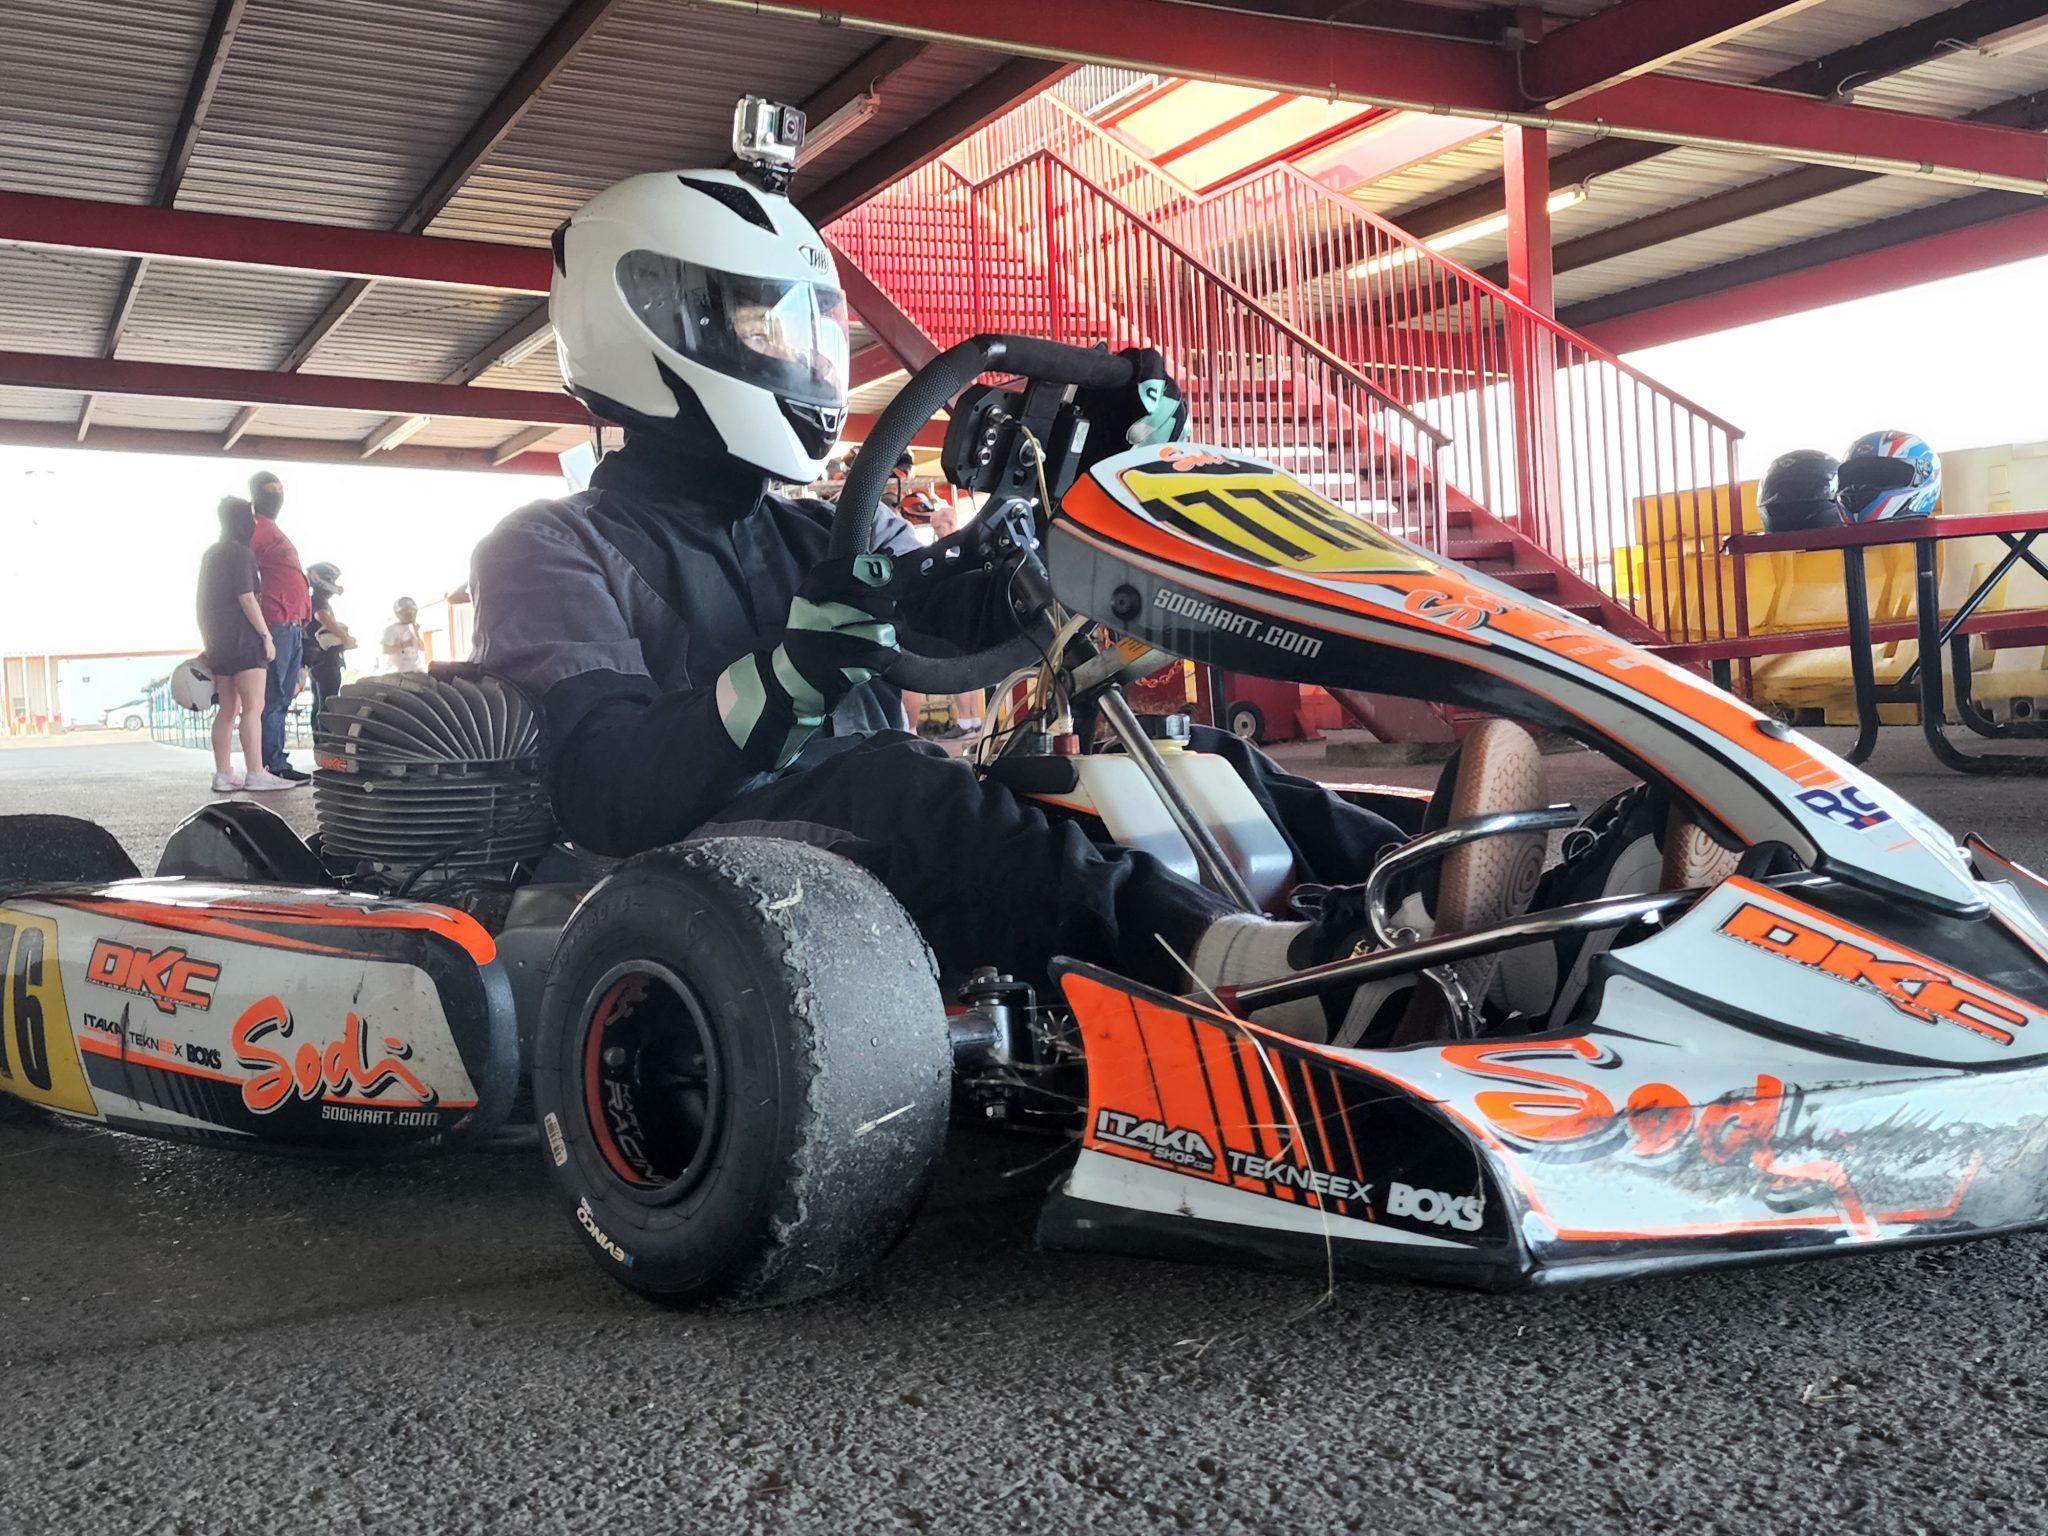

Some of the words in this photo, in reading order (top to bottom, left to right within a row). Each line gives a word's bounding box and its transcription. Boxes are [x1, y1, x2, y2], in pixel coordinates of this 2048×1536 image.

[86, 938, 222, 1015] DKC
[1716, 901, 2029, 1046] DKC
[231, 993, 439, 1115] Sodi
[1098, 1109, 1215, 1160] ITAKA
[1228, 1151, 1374, 1204] TEKNEEX
[576, 1207, 625, 1262] EVINCO
